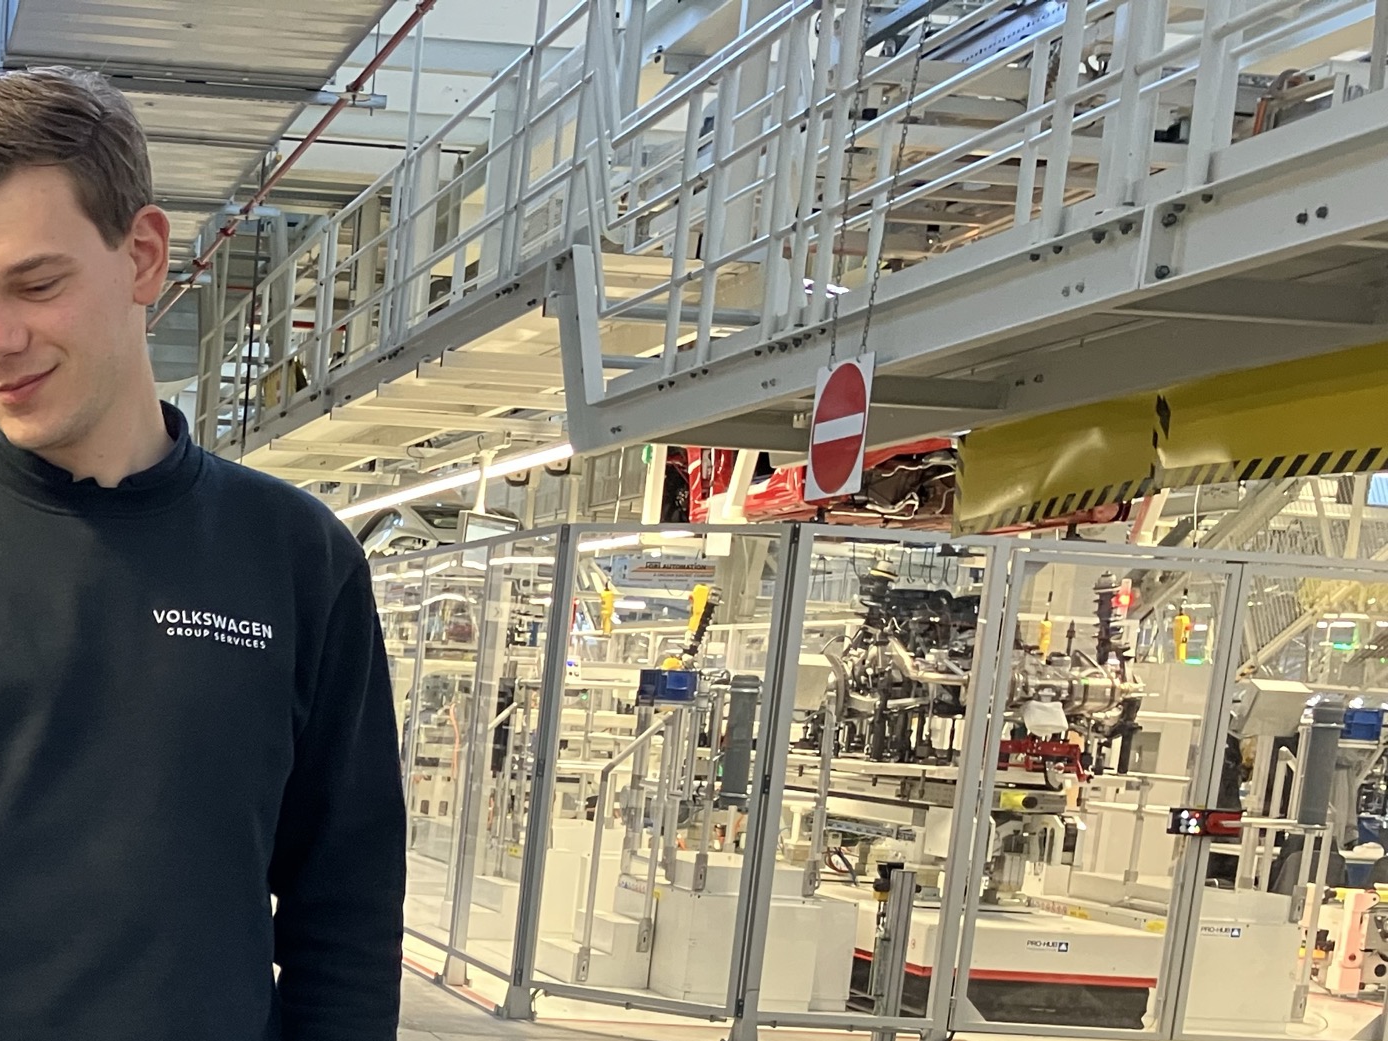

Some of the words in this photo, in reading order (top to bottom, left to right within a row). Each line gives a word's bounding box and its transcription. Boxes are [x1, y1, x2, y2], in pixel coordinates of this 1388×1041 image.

[153, 609, 272, 639] VOLKSWAGEN
[166, 627, 210, 637] GROUP
[213, 632, 266, 649] SERVICES
[1026, 939, 1058, 948] PRO-HUB
